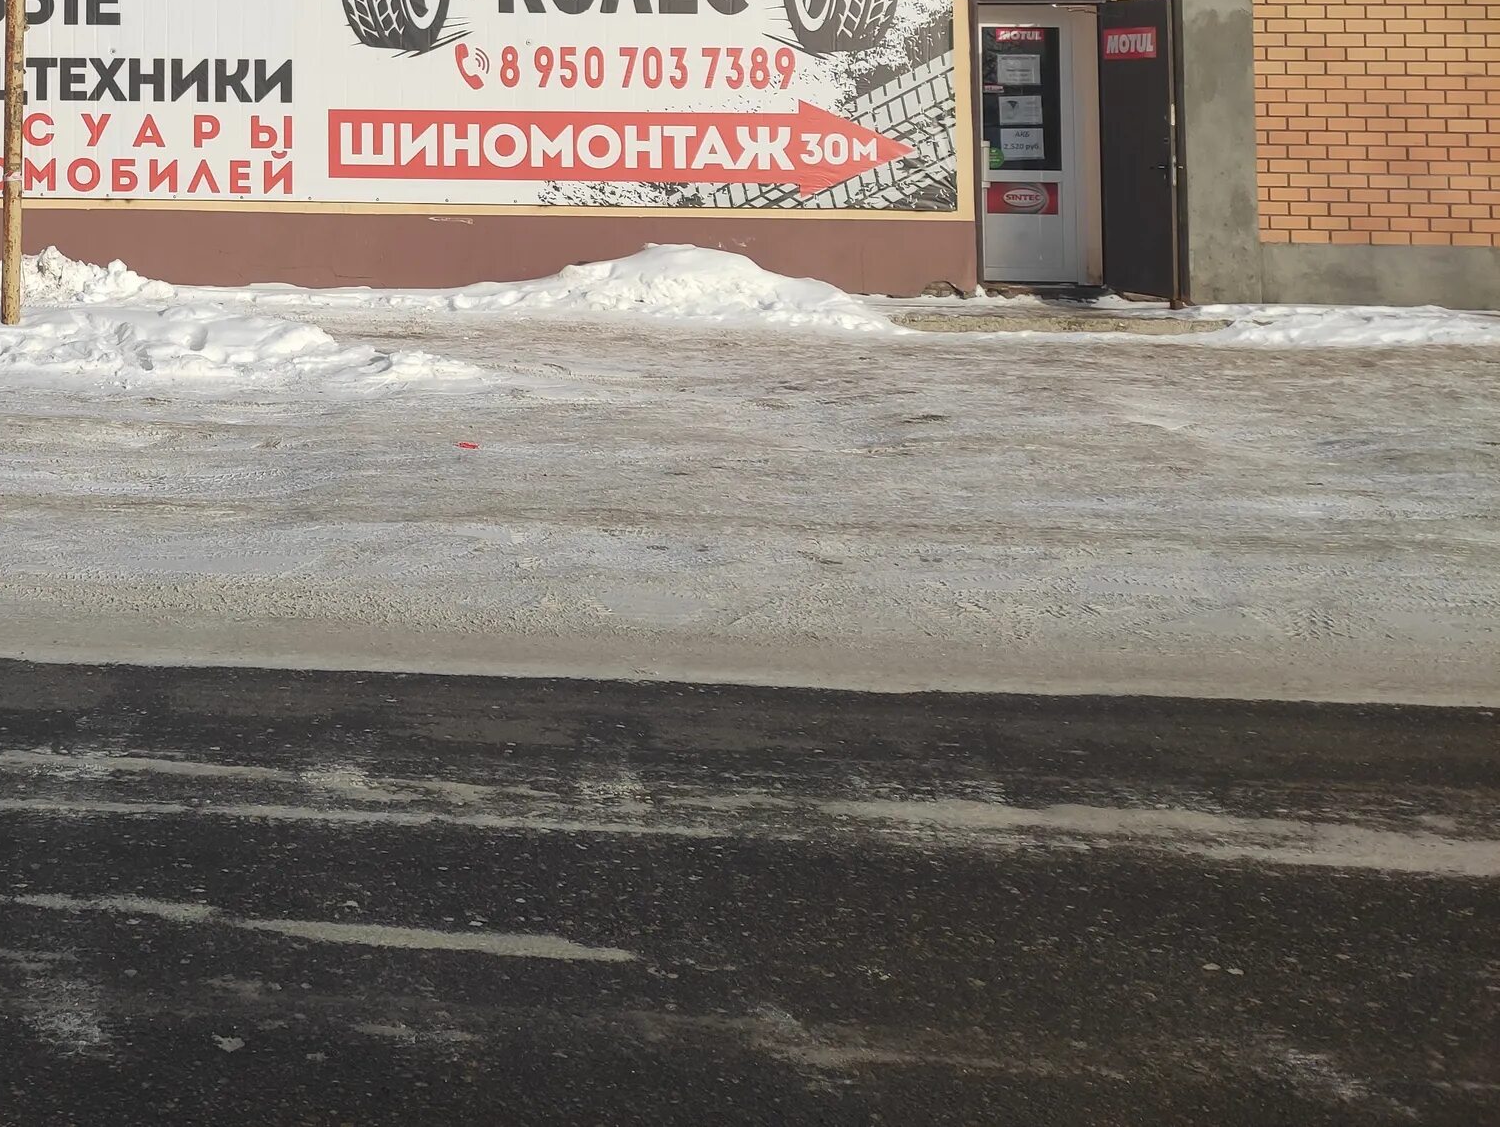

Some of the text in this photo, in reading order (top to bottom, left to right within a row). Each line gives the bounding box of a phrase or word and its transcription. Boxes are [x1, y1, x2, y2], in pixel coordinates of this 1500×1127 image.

[999, 30, 1041, 41] MOTUL
[1106, 33, 1154, 54] MOTUL
[499, 46, 796, 90] 8 950 703 7389
[340, 122, 795, 170] ШИНОМОНТАЖ
